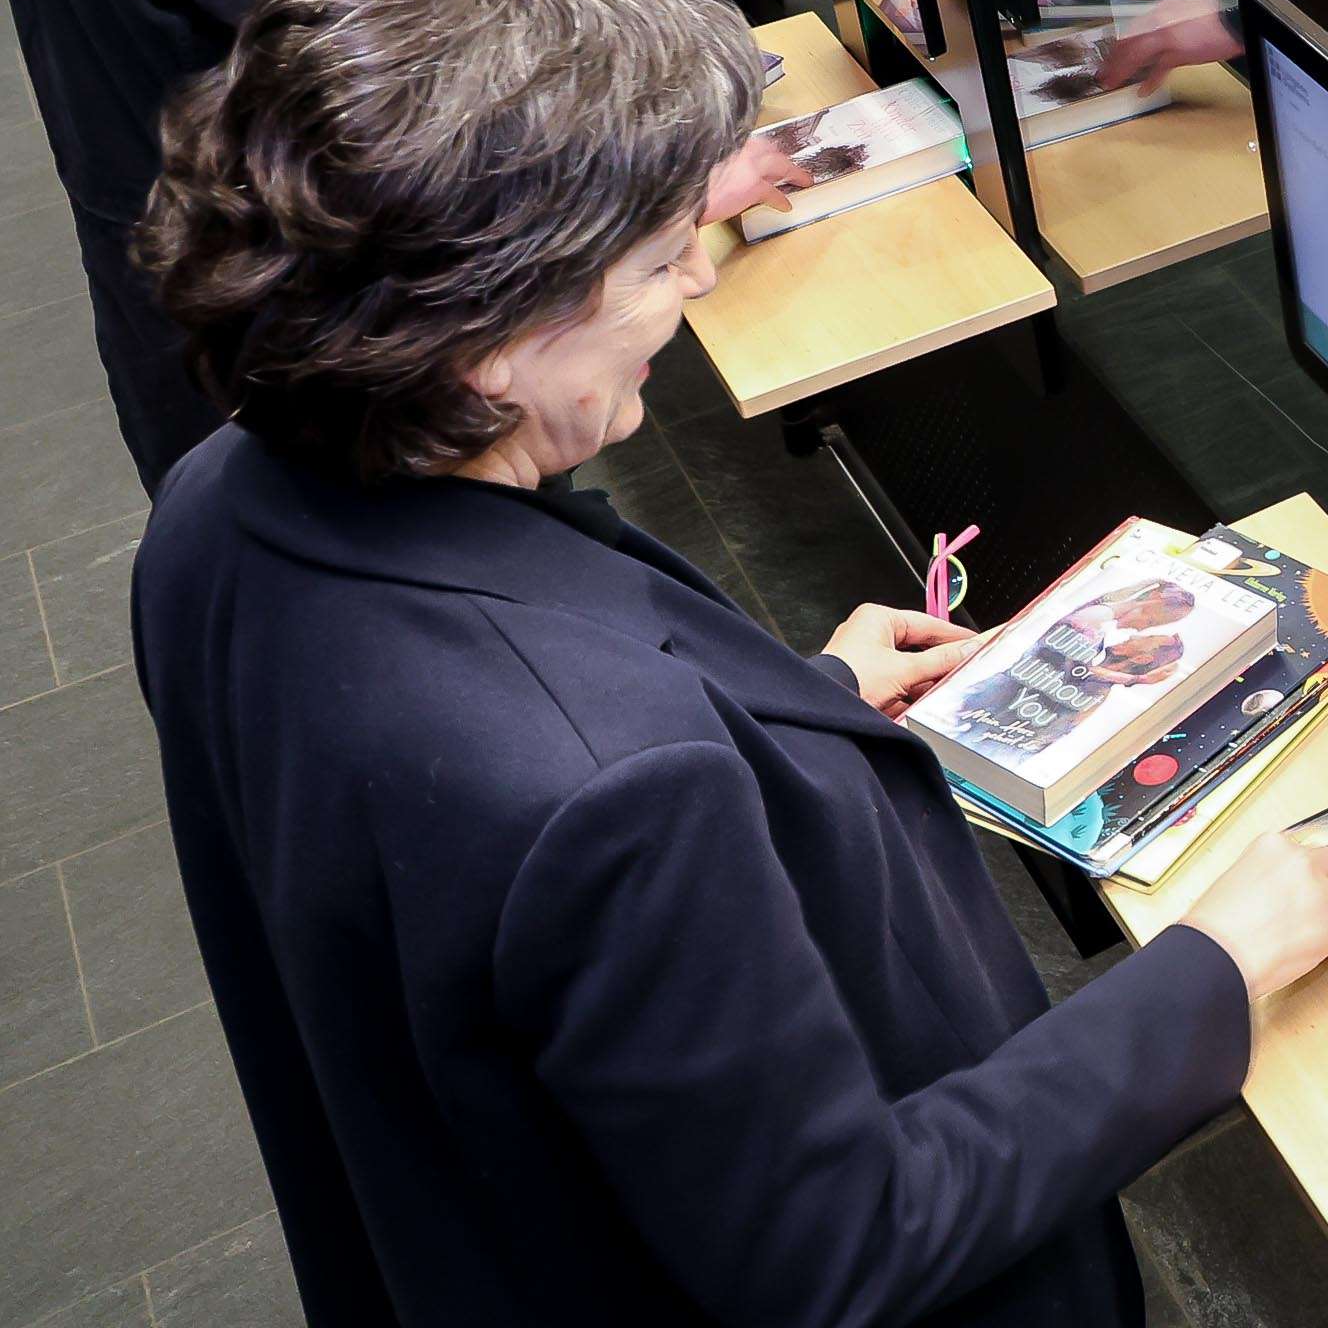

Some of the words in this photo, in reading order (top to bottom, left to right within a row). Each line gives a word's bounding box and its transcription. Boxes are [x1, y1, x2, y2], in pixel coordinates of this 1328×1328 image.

[1221, 589, 1267, 613] LEE
[1044, 624, 1100, 664] With
[1009, 656, 1106, 711] Without
[1071, 665, 1093, 680] or
[1008, 686, 1058, 726] You
